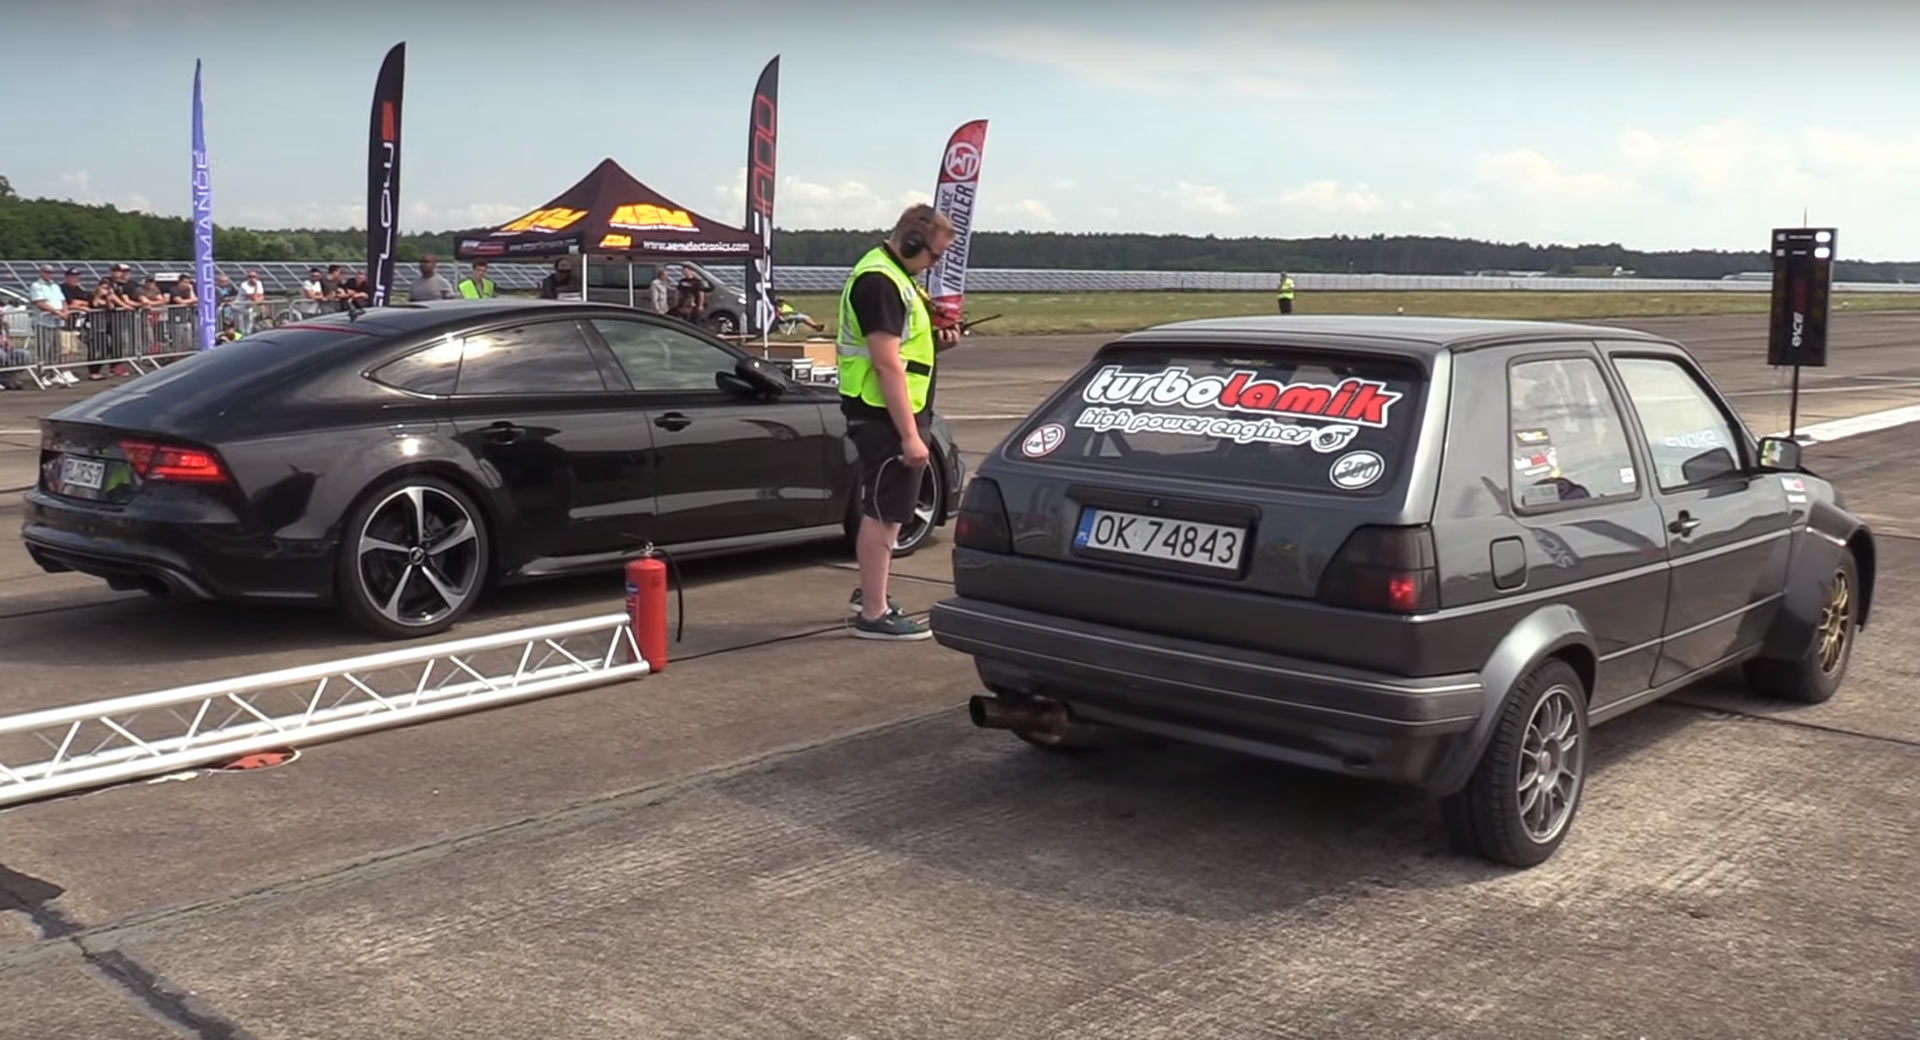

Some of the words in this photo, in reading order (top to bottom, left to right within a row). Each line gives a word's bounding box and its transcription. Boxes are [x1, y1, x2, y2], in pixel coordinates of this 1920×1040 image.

[1084, 366, 1400, 426] turbolamik
[1079, 407, 1131, 431] high
[1129, 413, 1210, 432] power
[1209, 420, 1315, 443] engines
[1095, 515, 1136, 549] OK
[1142, 521, 1237, 564] 74843
